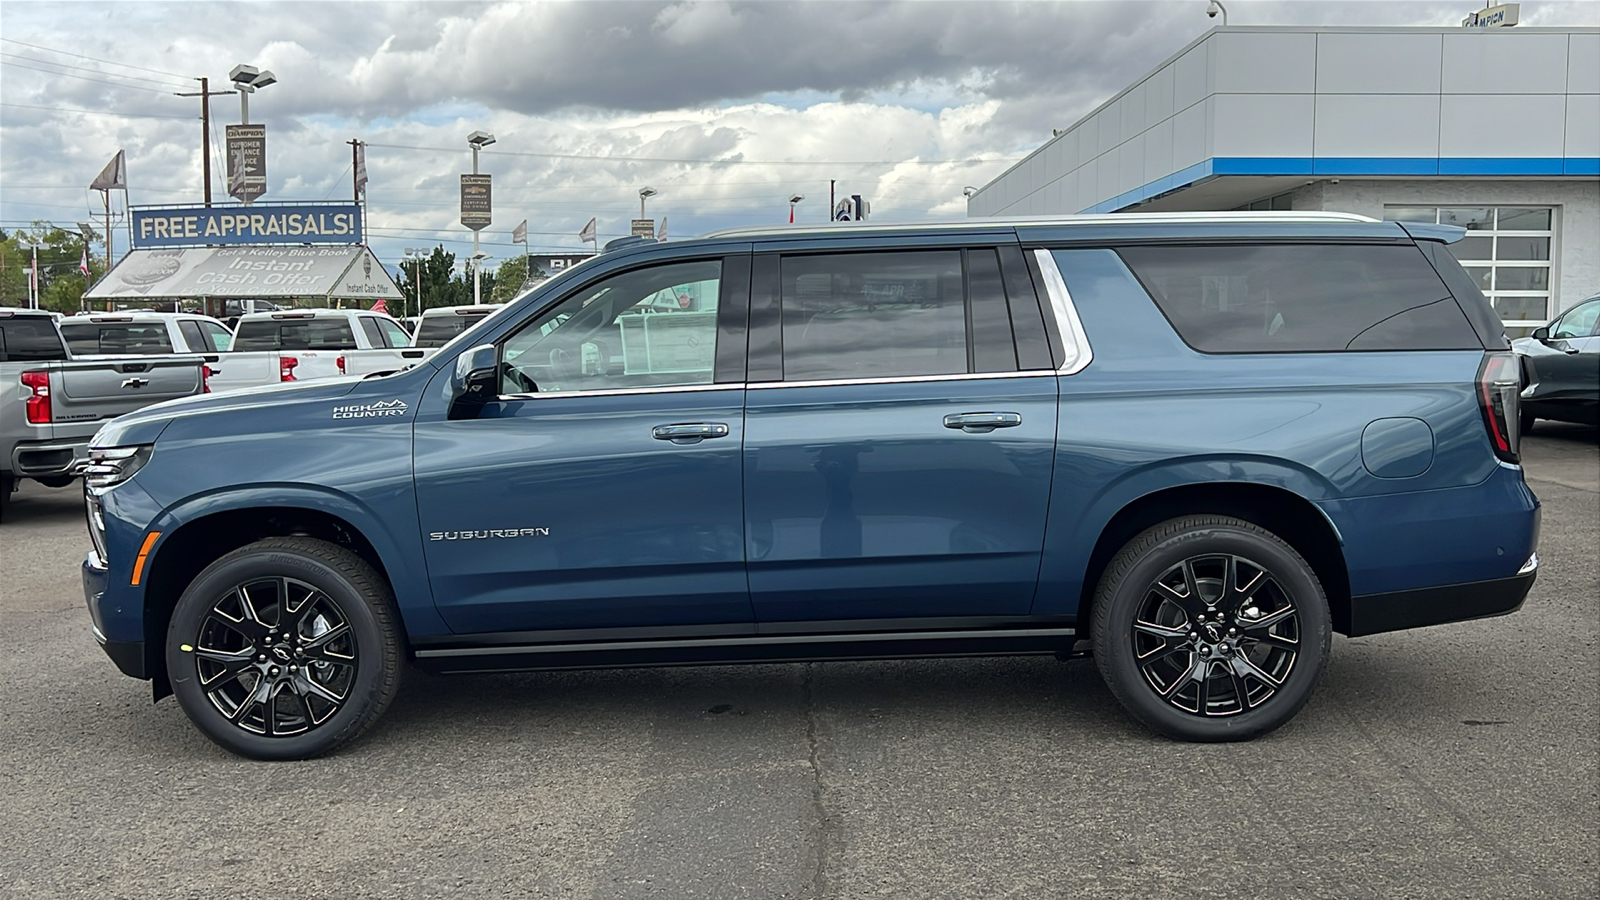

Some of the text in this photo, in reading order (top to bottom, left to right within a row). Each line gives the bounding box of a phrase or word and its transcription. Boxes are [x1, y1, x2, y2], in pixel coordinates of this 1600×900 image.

[1466, 10, 1504, 27] CMPION
[140, 213, 354, 238] FREE APPRAISALS!
[249, 249, 286, 258] Kelley
[318, 248, 350, 256] Book
[228, 257, 315, 271] Instant
[196, 272, 326, 284] Cash Offer
[210, 285, 243, 294] Your
[276, 286, 319, 294] Now!
[347, 283, 388, 293] Instant Cash Offer
[333, 404, 372, 412] HIGH
[333, 409, 407, 419] COUNTRY
[430, 527, 549, 540] SUBURBAN
